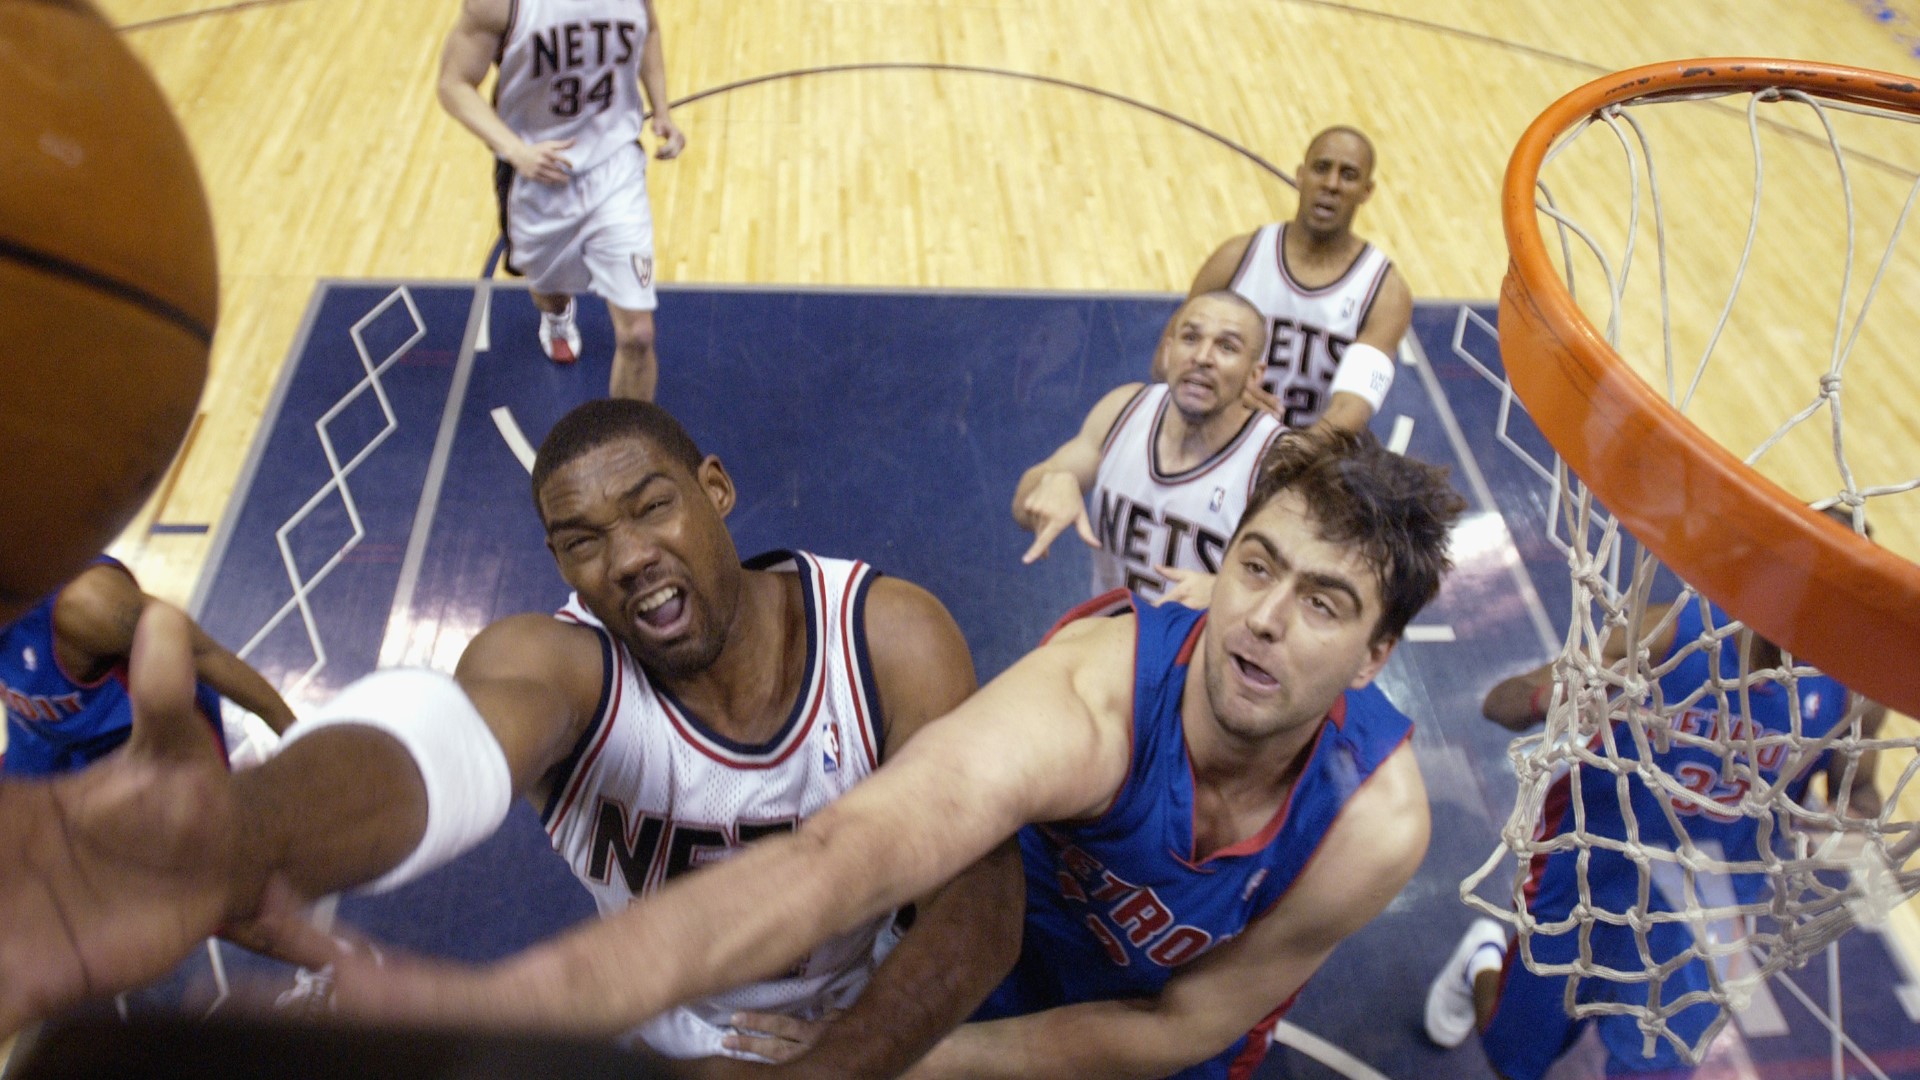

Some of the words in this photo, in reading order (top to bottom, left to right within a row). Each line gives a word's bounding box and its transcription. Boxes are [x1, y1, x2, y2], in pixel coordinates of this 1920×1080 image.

[531, 21, 636, 79] NETS
[551, 70, 615, 118] 34
[1264, 316, 1355, 384] ETS
